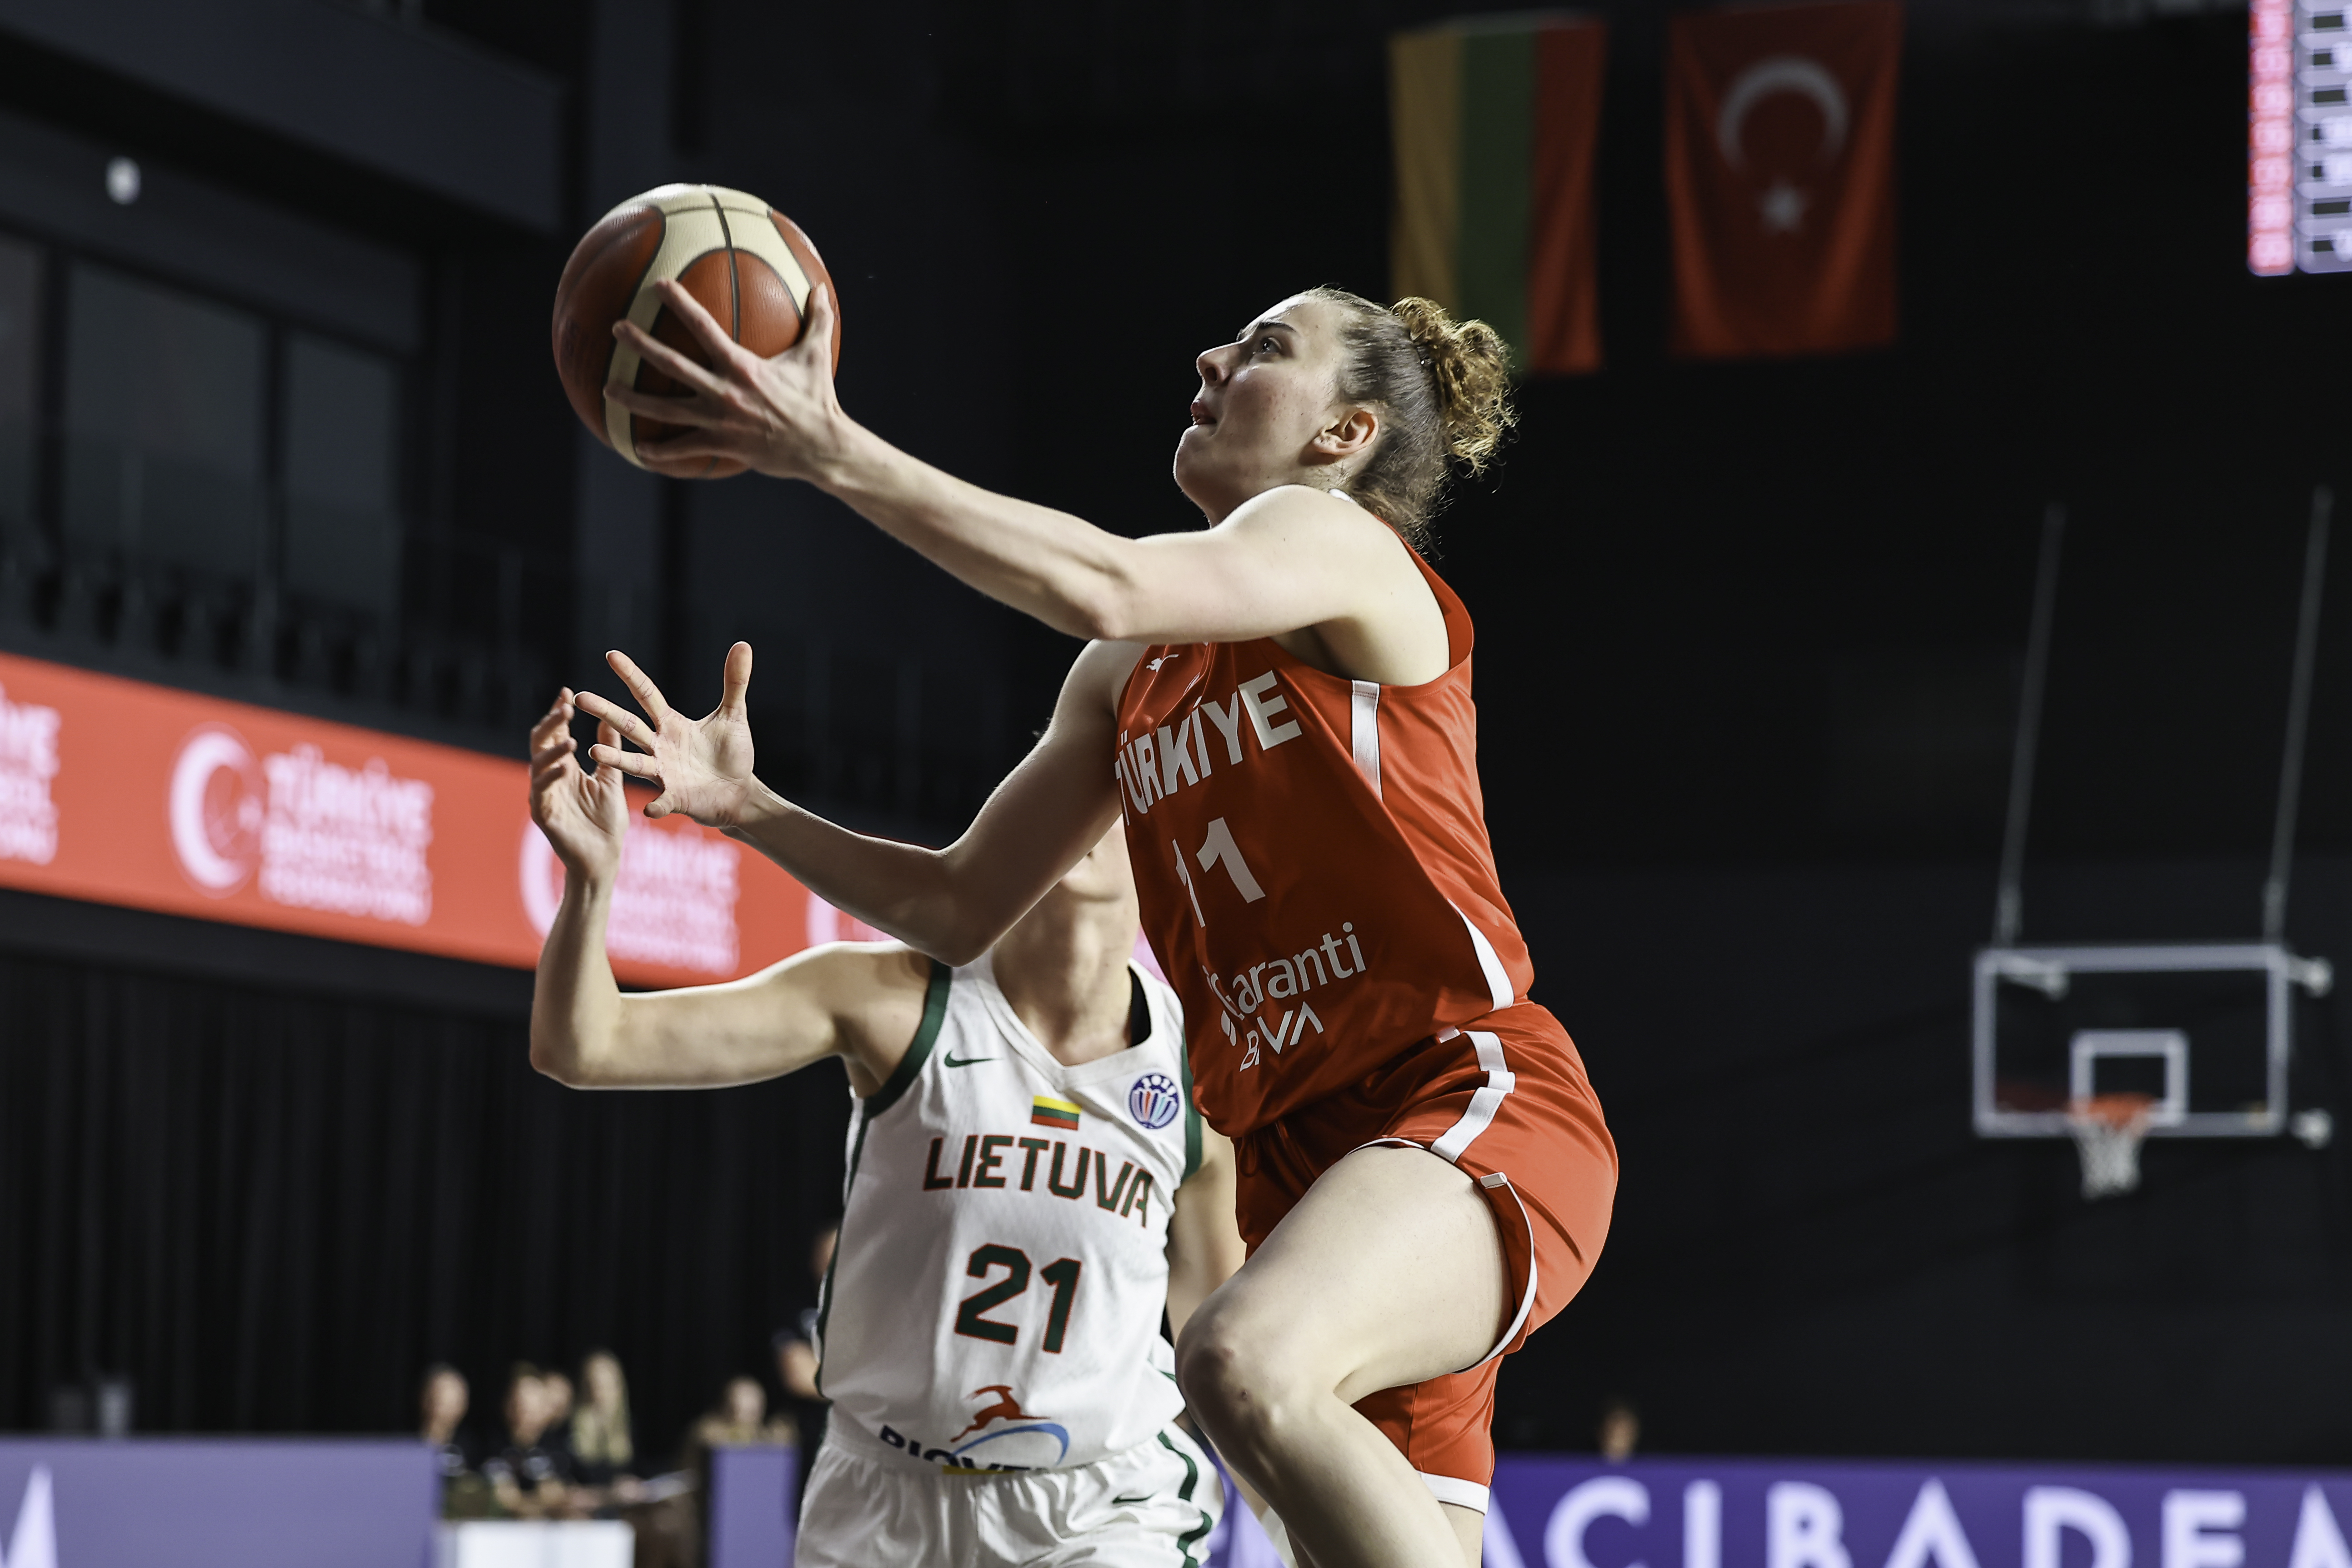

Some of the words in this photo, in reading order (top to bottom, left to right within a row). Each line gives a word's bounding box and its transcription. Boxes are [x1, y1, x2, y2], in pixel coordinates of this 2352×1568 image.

[1114, 670, 1302, 826] TÜRKİYE
[1172, 817, 1266, 928] 11
[923, 1135, 1153, 1228] LIETUVA
[954, 1242, 1081, 1354] 21
